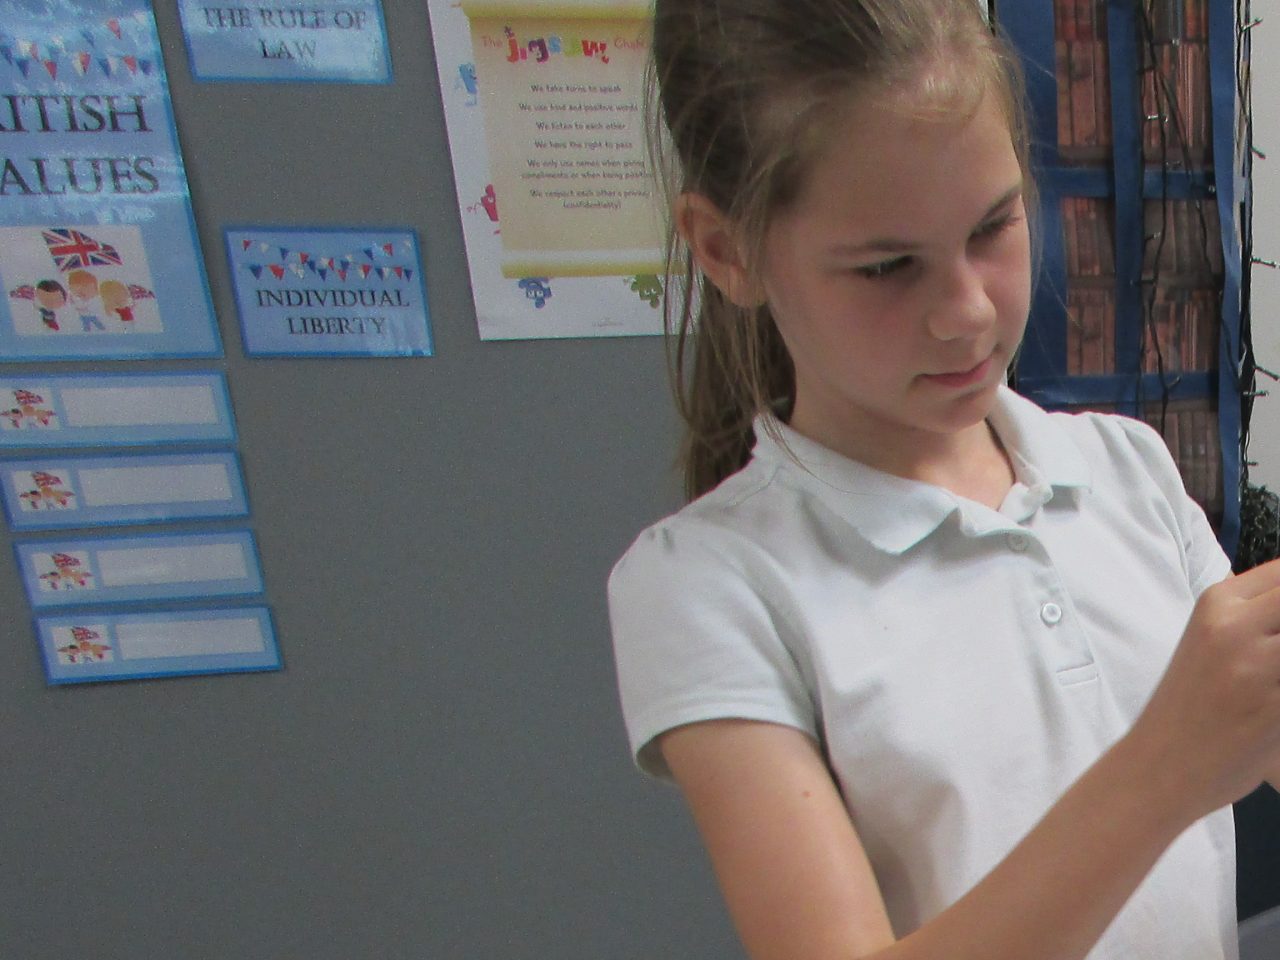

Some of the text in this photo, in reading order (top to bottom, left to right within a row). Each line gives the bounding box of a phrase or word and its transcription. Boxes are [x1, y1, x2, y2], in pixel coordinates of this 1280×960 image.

[203, 8, 366, 29] THE RULE OF
[260, 38, 317, 59] LAW
[256, 289, 410, 308] INDIVIDUAL
[286, 317, 387, 336] LIBERTY
